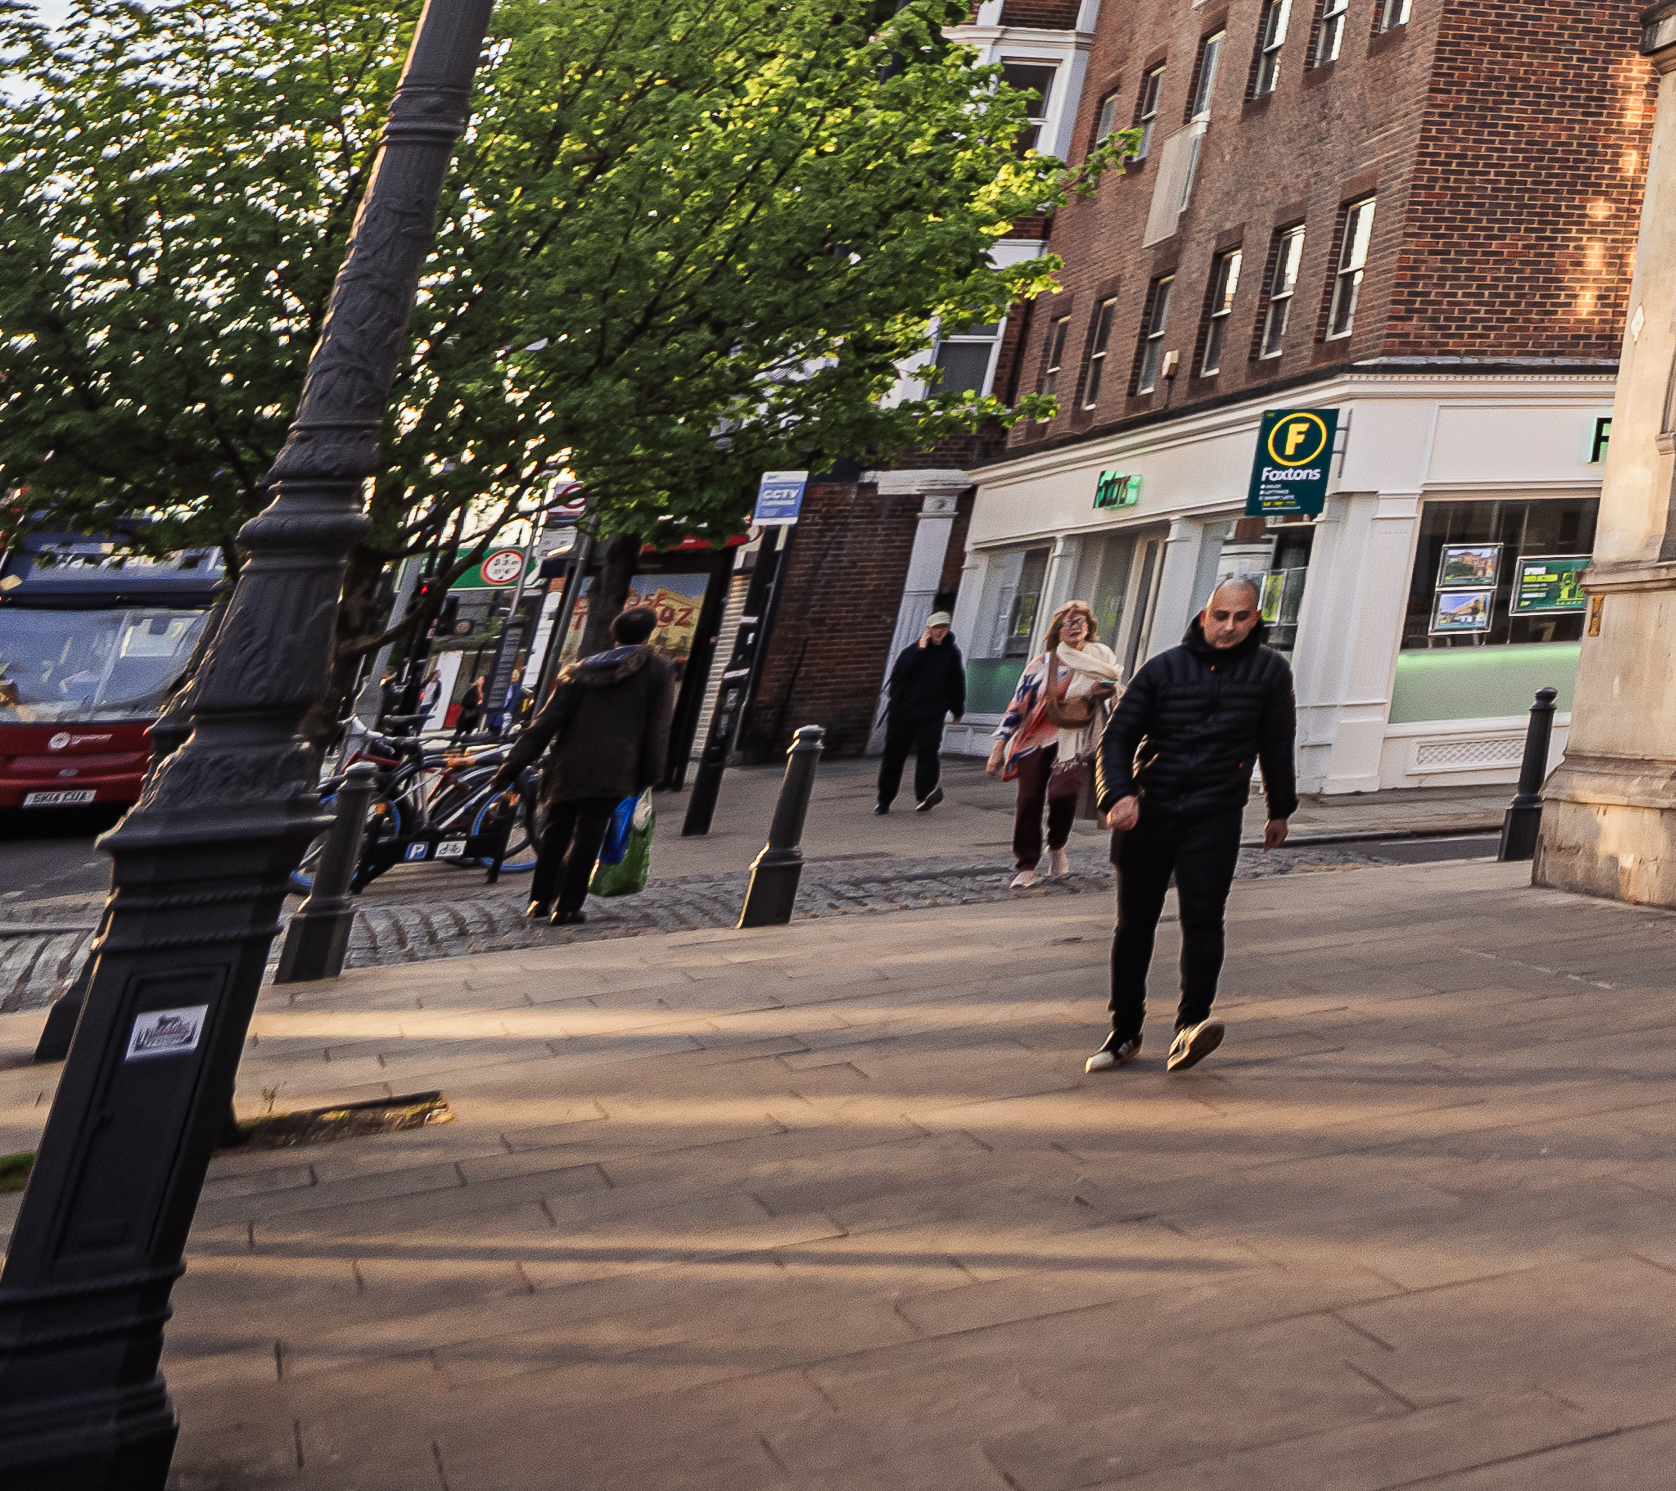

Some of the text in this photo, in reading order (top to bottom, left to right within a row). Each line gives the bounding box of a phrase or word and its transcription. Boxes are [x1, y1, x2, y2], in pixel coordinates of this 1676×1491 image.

[1284, 422, 1310, 456] F
[1261, 466, 1322, 482] Foxtons
[761, 489, 799, 501] CCTV
